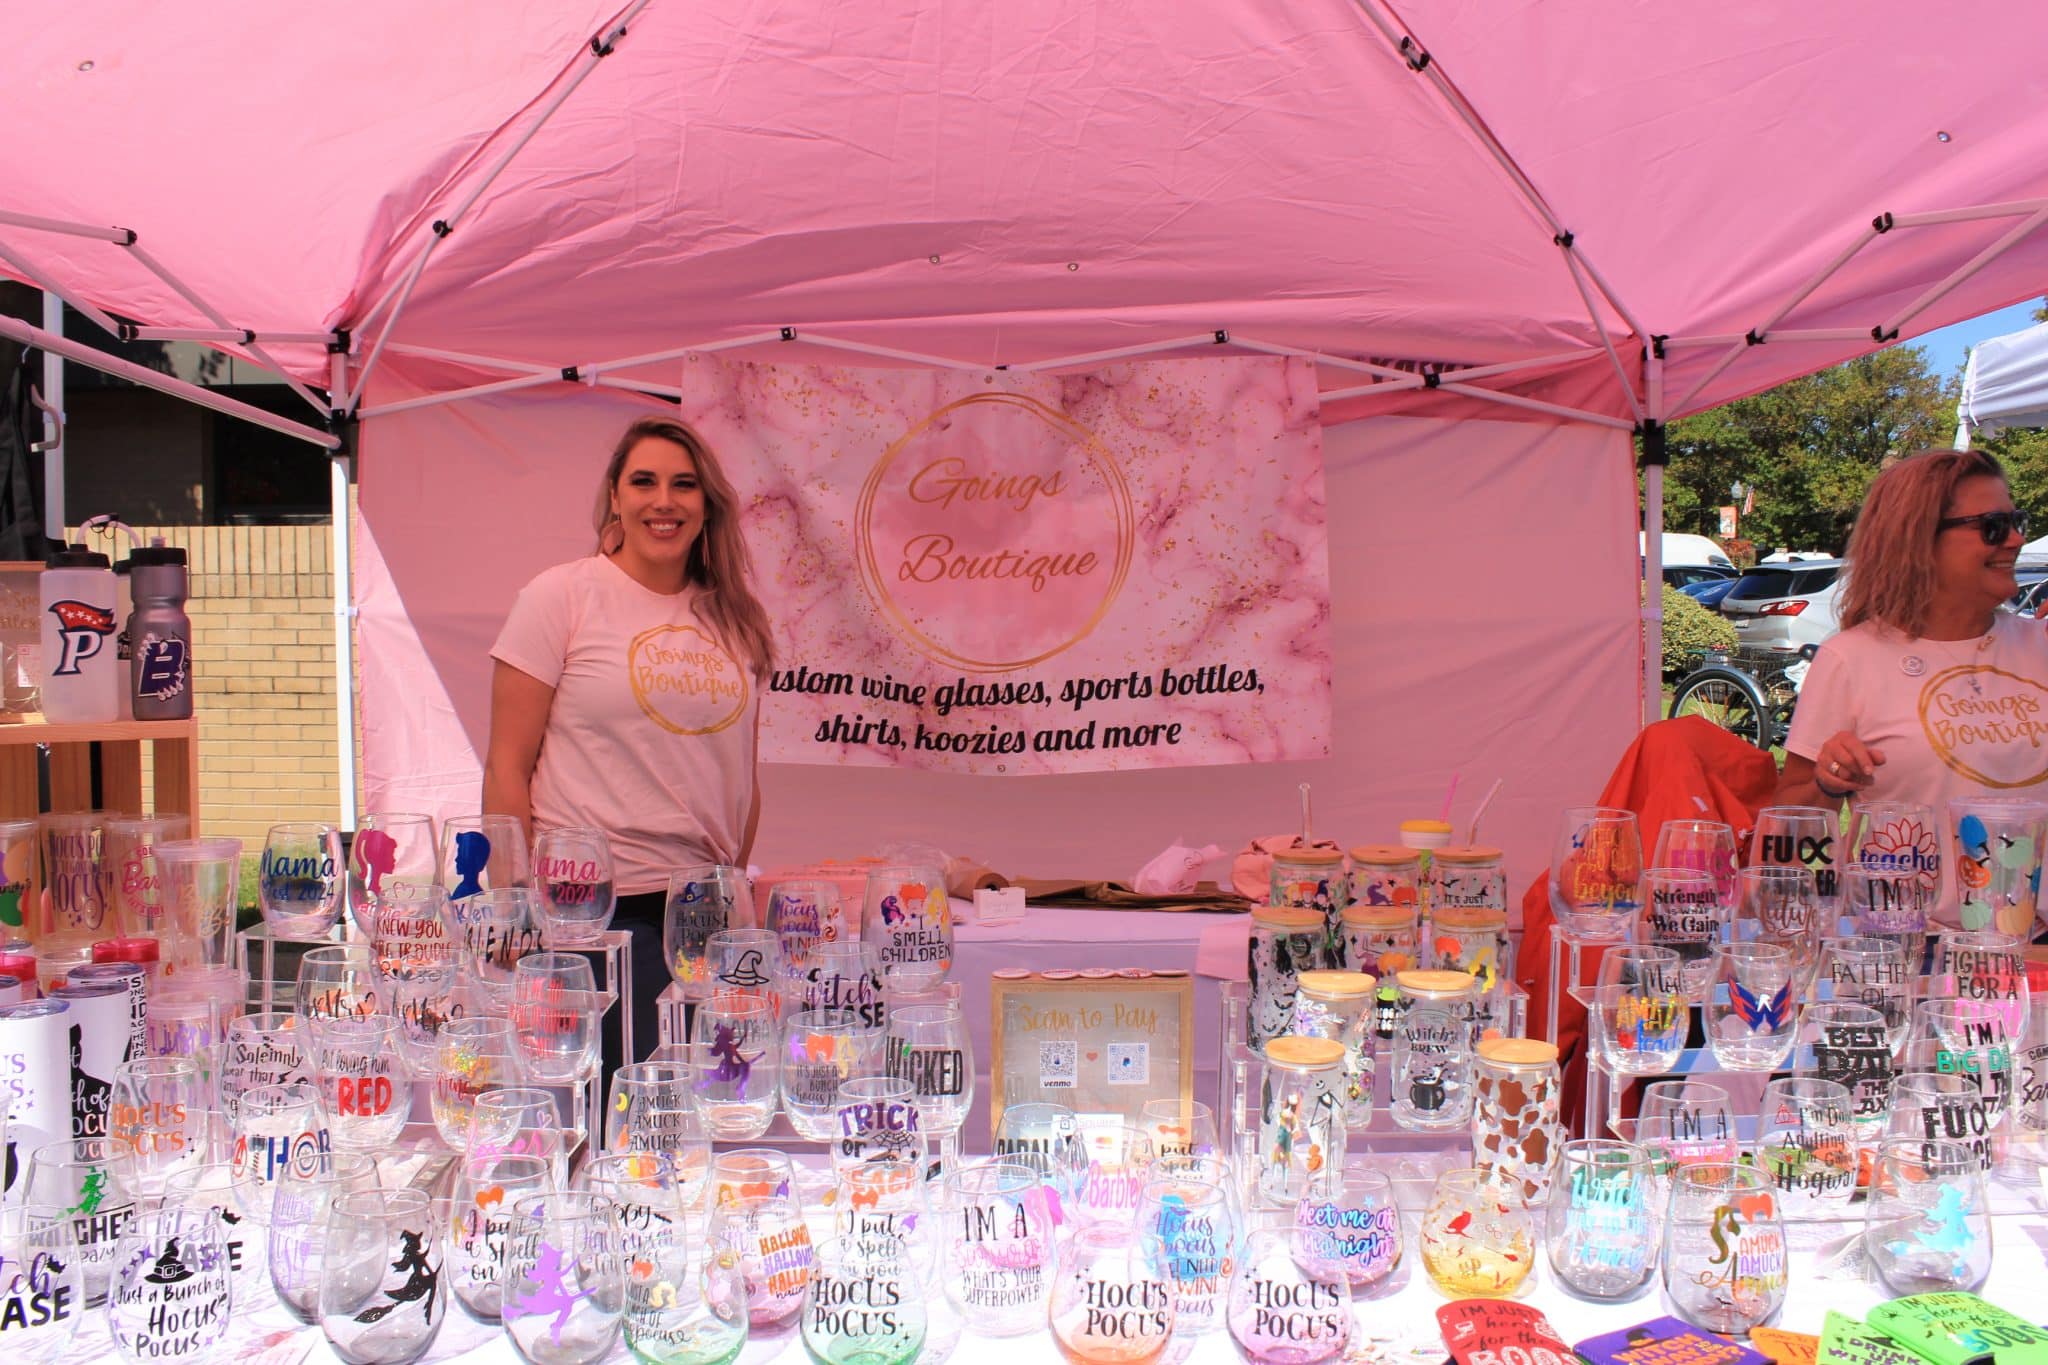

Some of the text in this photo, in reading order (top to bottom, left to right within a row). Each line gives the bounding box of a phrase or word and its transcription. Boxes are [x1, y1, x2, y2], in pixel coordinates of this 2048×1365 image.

[908, 457, 1068, 511] Goings
[899, 534, 1098, 592] Boutique
[645, 643, 724, 675] Goings
[639, 665, 739, 704] Boutique
[770, 663, 1265, 715] ustom wine glasses, sports bottles,
[1936, 693, 2040, 721] Goings
[815, 716, 1181, 754] shirts, koozies and more
[881, 944, 951, 962] CHILDREN
[893, 930, 944, 947] SMELL
[1958, 976, 1999, 1000] FOR
[1019, 1003, 1158, 1033] Scan to Pay
[338, 1076, 392, 1116] RED
[1044, 1080, 1071, 1088] venmo
[634, 1111, 682, 1130] AMUCK
[838, 1102, 919, 1137] TRICK
[1669, 1107, 1727, 1141] I'M A
[630, 1133, 682, 1151] AMUCK
[842, 1139, 867, 1157] or
[1089, 1160, 1138, 1209] Barbie
[963, 1203, 1028, 1241] I'M A
[1298, 1199, 1396, 1232] Meet me at
[1740, 1231, 1781, 1256] AMUCK
[962, 1264, 1042, 1289] WHAT'S YOUR
[1740, 1252, 1782, 1274] AMUCK
[118, 1285, 143, 1305] Just
[164, 1278, 213, 1301] Bunch
[815, 1277, 900, 1308] HOCUS
[1087, 1280, 1168, 1310] HOCUS
[1254, 1280, 1340, 1310] HOCUS
[814, 1306, 896, 1337] POCUS
[1085, 1308, 1166, 1340] POCUS
[1254, 1309, 1338, 1342] POCUS
